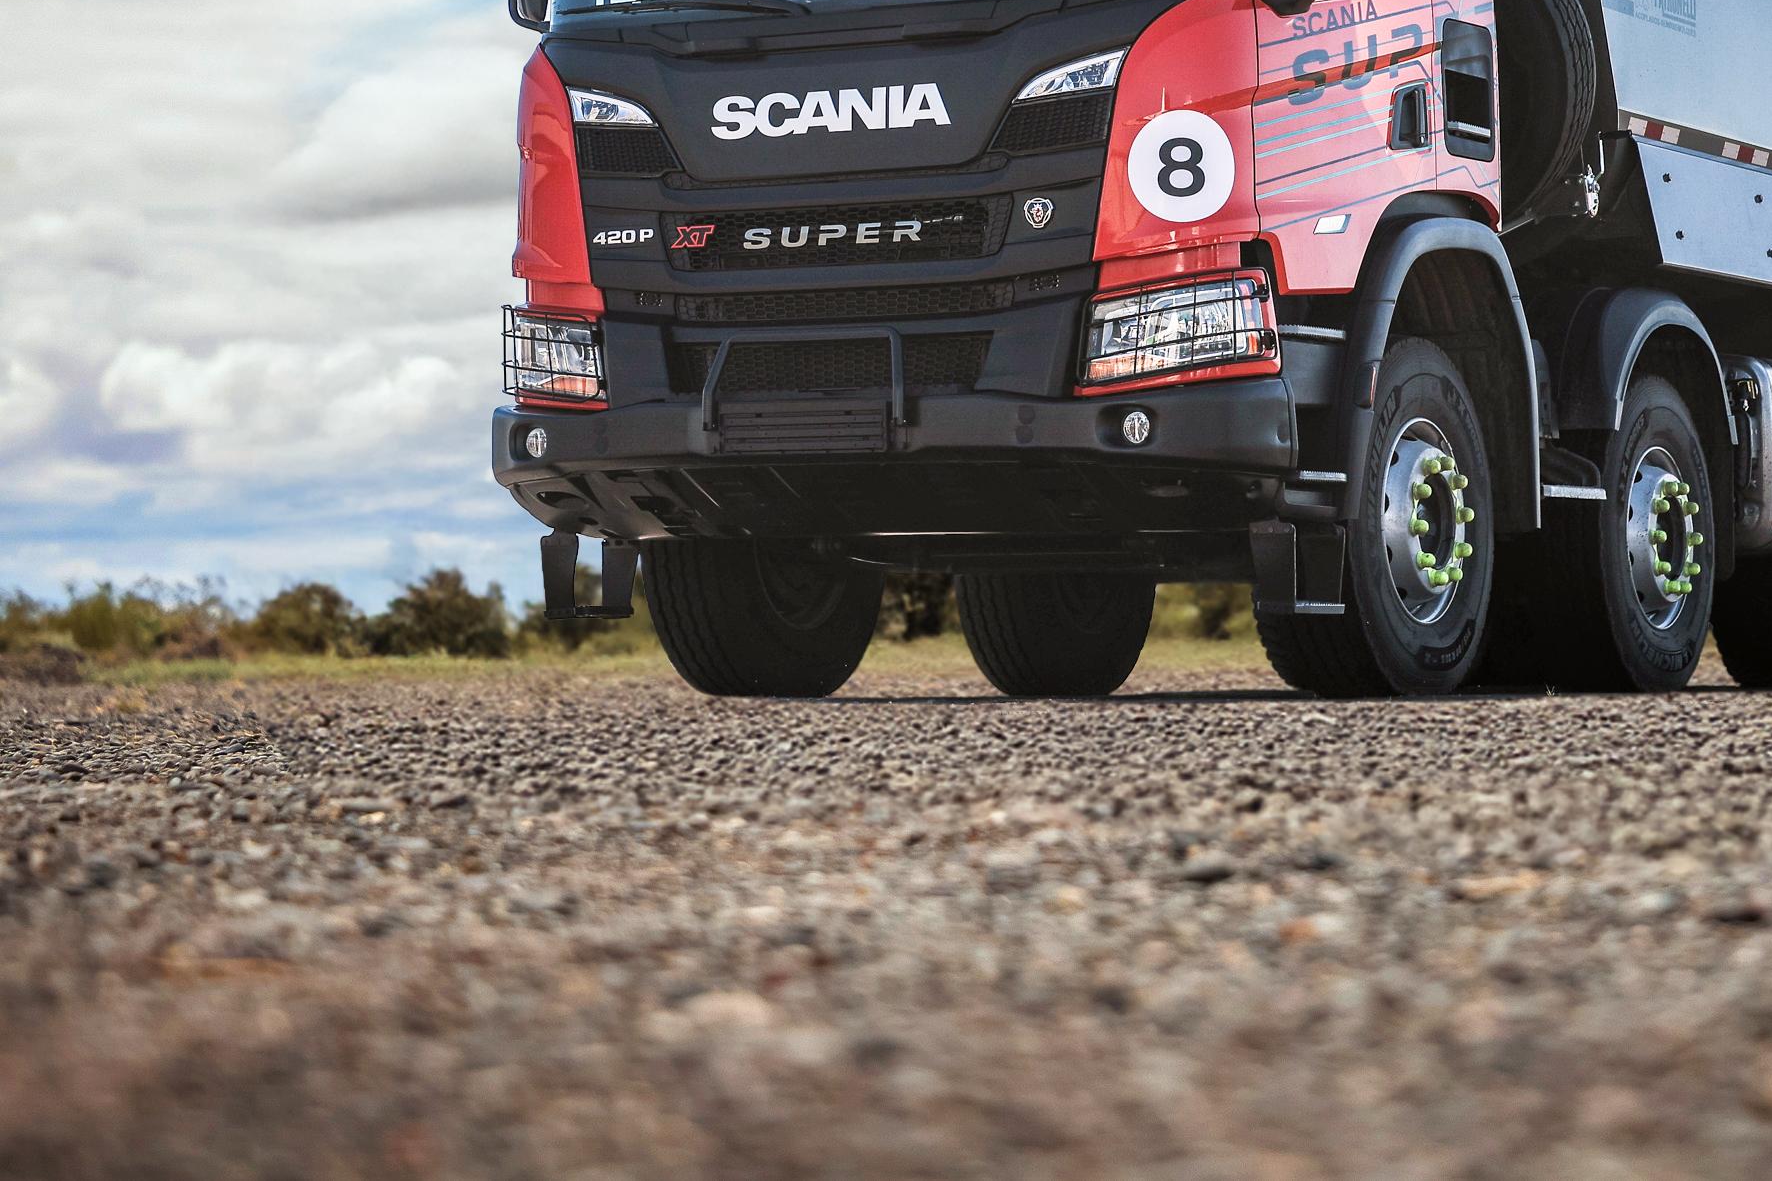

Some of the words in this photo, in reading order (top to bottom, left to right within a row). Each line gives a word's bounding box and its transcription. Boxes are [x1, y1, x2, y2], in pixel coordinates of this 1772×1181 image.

[711, 82, 951, 140] SCANIA
[1157, 137, 1206, 198] 8
[592, 230, 636, 245] 420
[639, 228, 654, 243] P
[671, 224, 715, 249] XT
[743, 220, 922, 250] SUPER
